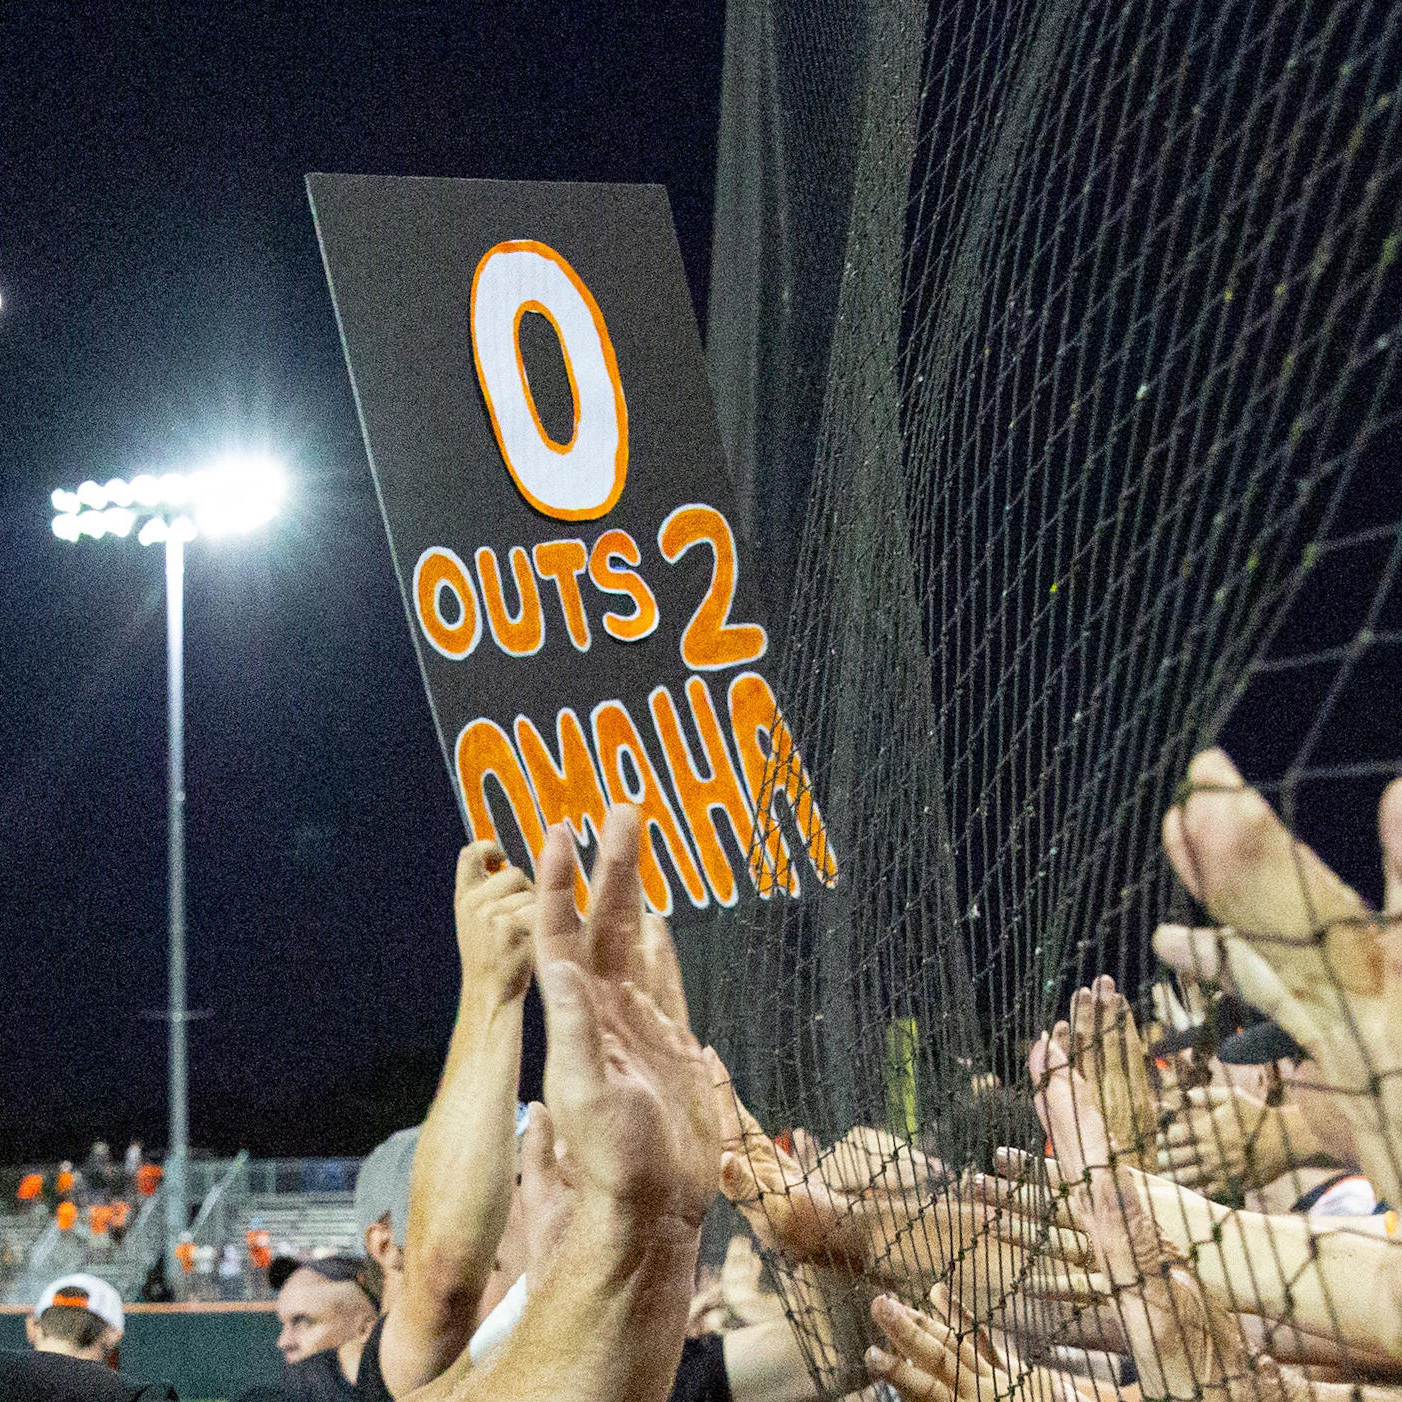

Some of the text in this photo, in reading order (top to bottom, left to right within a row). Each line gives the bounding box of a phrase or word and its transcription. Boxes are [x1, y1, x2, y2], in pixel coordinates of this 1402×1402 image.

[470, 239, 629, 521] 0
[412, 503, 768, 671] OUTS 2
[455, 672, 839, 918] OMAHA
